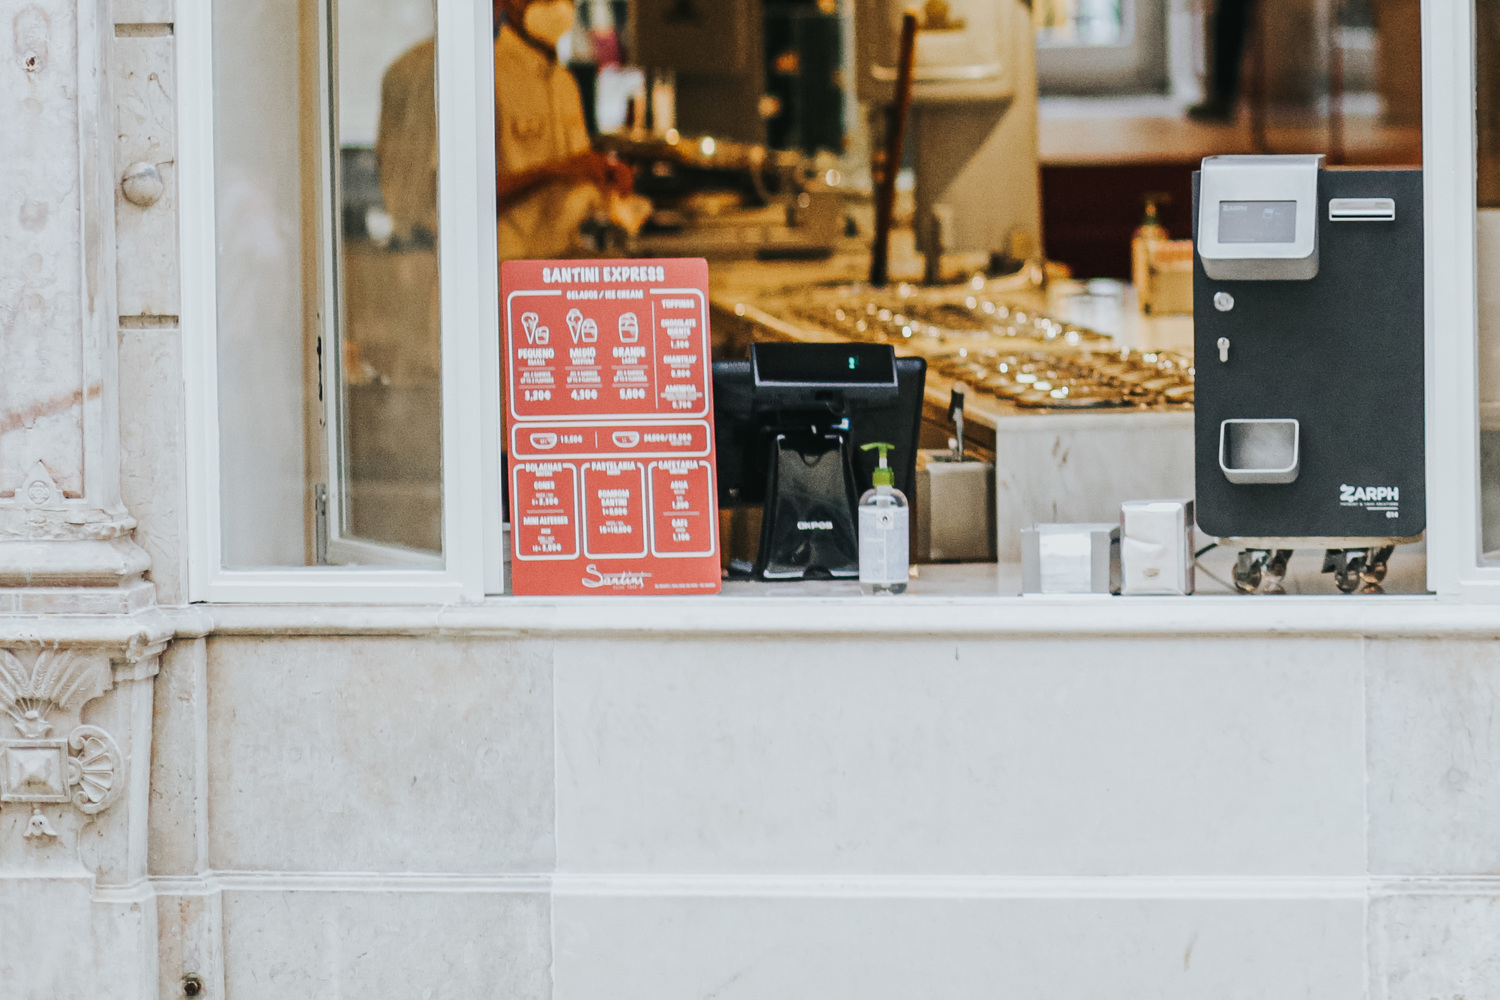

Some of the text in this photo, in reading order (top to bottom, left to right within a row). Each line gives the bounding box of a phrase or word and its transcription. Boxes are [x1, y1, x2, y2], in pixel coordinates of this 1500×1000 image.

[542, 265, 666, 284] SANTINI EXPRESS
[1340, 483, 1400, 503] ZARPH
